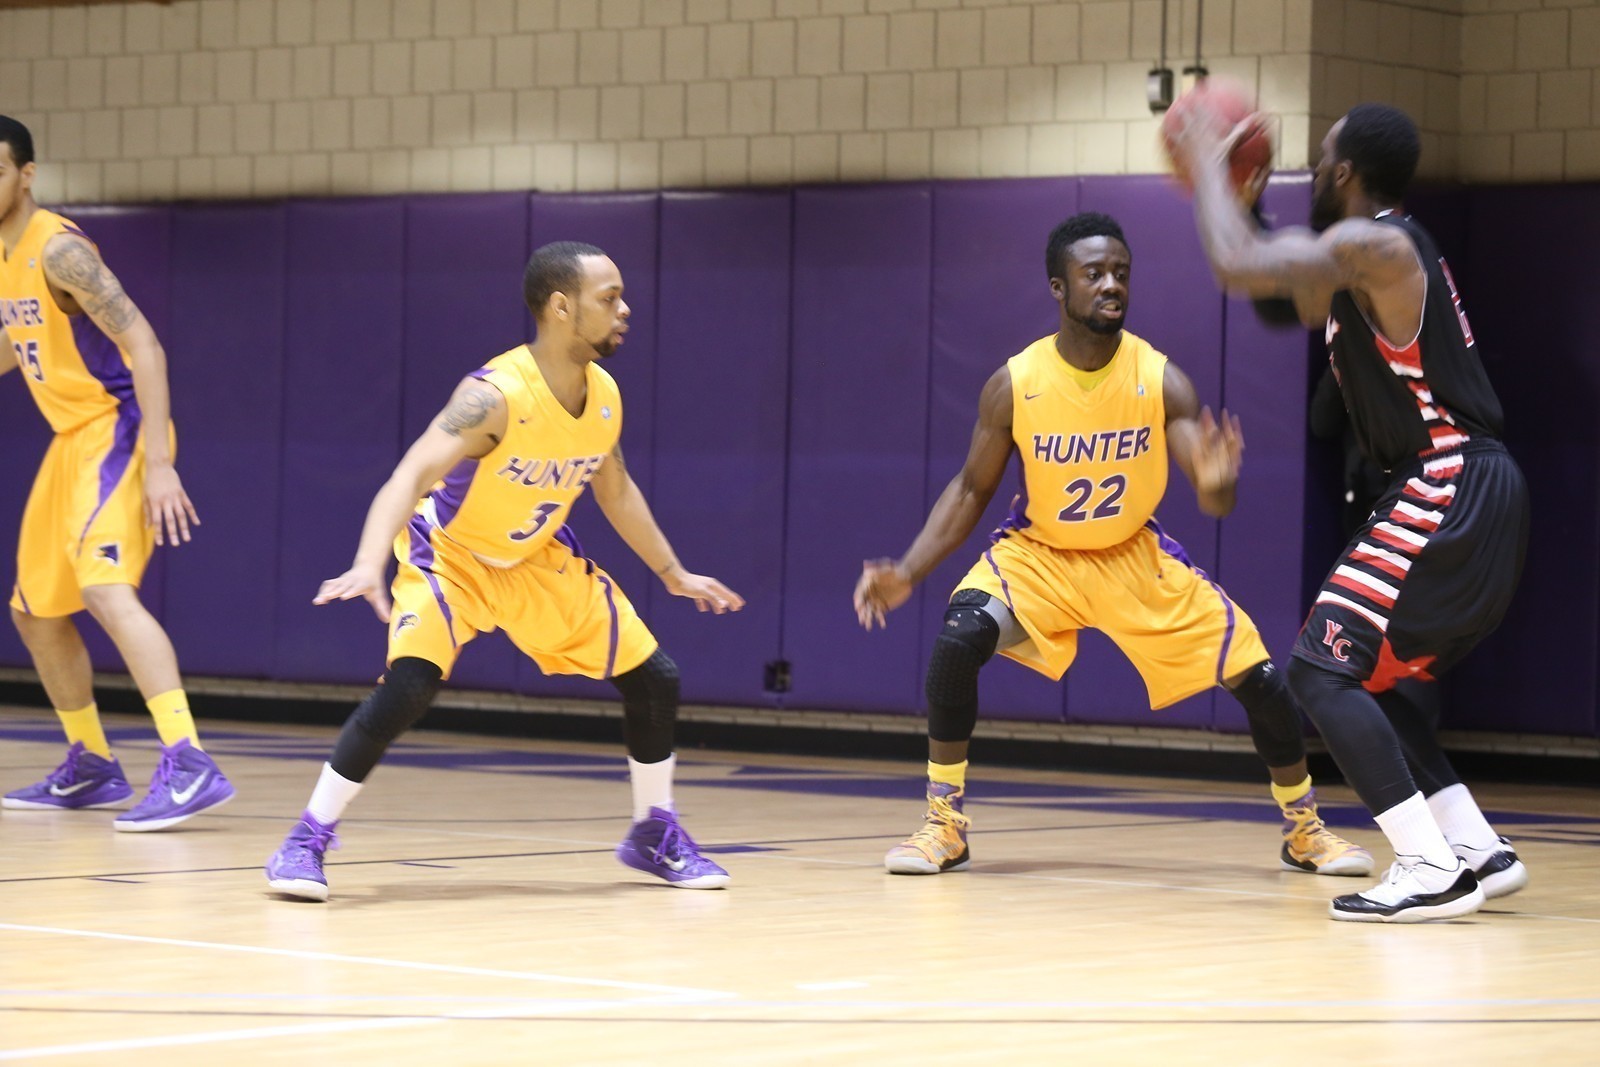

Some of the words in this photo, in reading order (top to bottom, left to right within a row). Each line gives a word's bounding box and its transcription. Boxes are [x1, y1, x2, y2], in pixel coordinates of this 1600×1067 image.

[0, 298, 43, 326] UNTER
[1033, 426, 1151, 464] HUNTER
[496, 453, 606, 490] HUNTE
[1057, 473, 1127, 522] 22
[508, 501, 563, 541] 3
